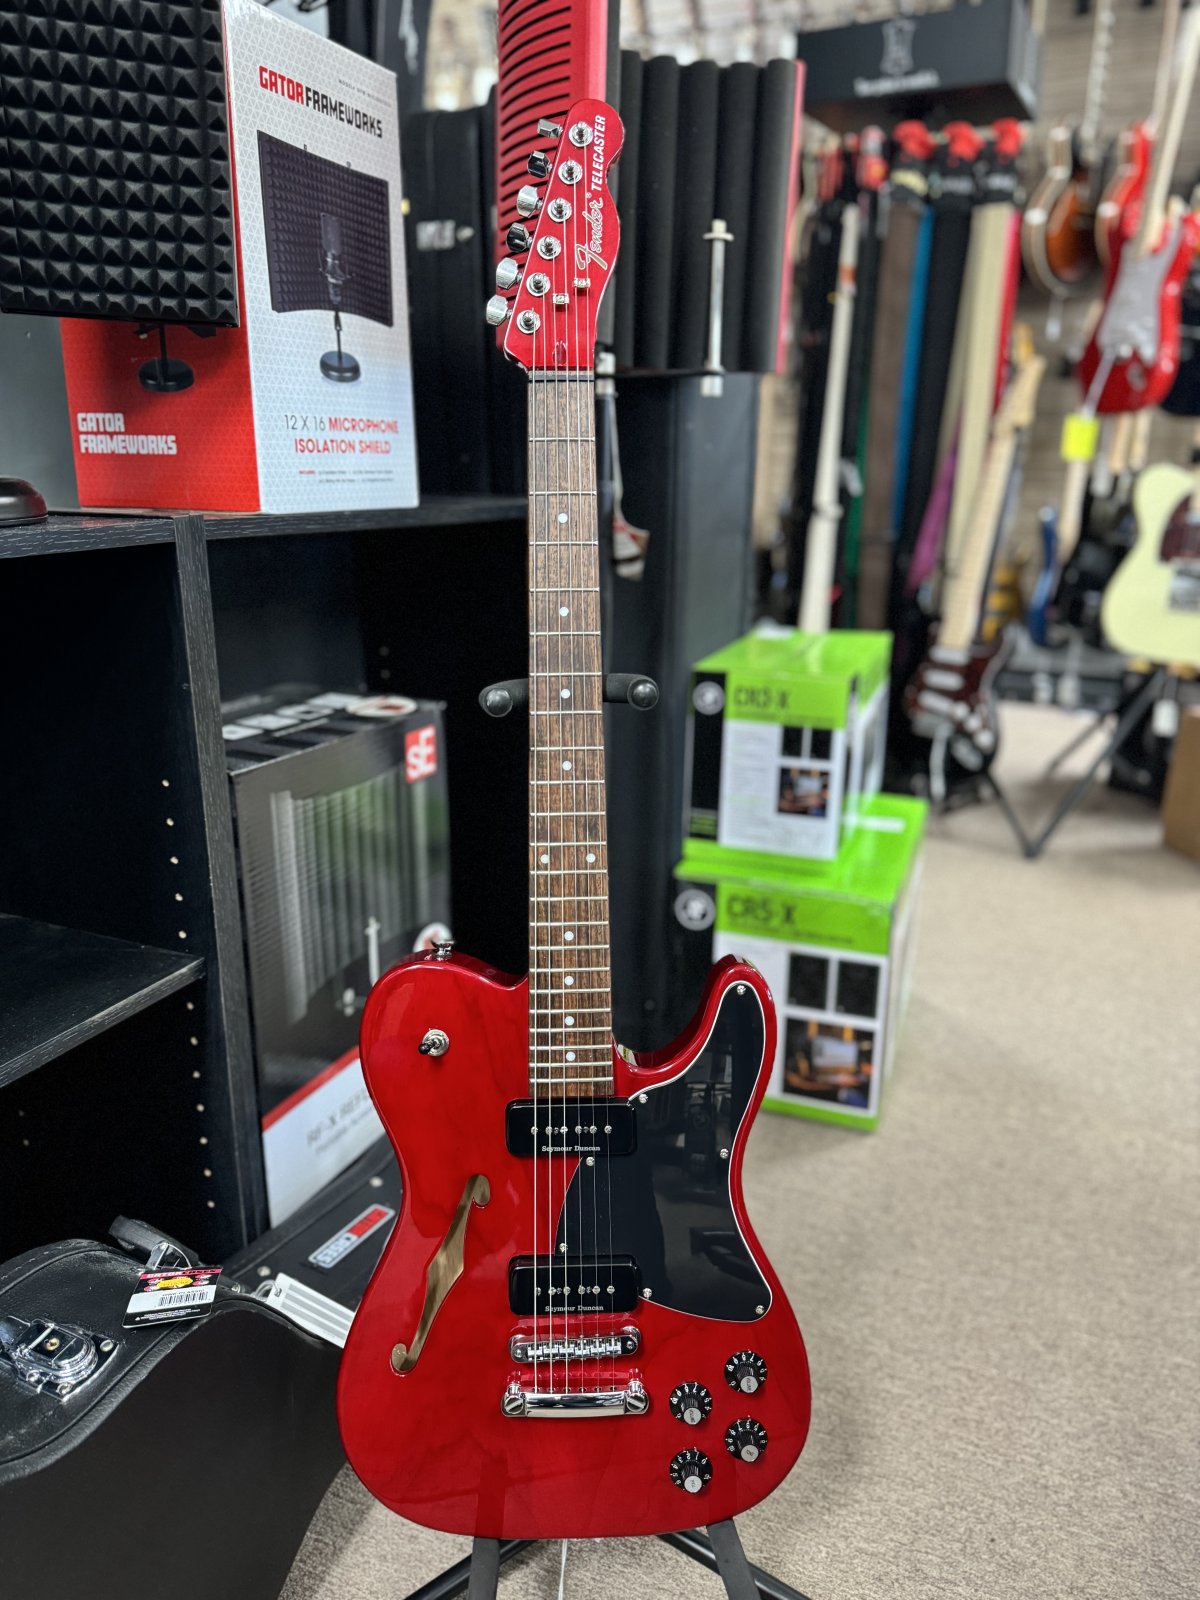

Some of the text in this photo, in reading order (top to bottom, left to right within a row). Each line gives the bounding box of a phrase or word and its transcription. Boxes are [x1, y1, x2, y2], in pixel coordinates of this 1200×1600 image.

[591, 114, 606, 191] TELECASTER
[575, 196, 609, 271] Fender
[77, 412, 125, 432] GATOR
[284, 414, 399, 434] 12 X 16 MICROPHONE
[79, 434, 177, 455] FRAMEWORKS
[294, 438, 391, 454] ISOLATION SHIELD
